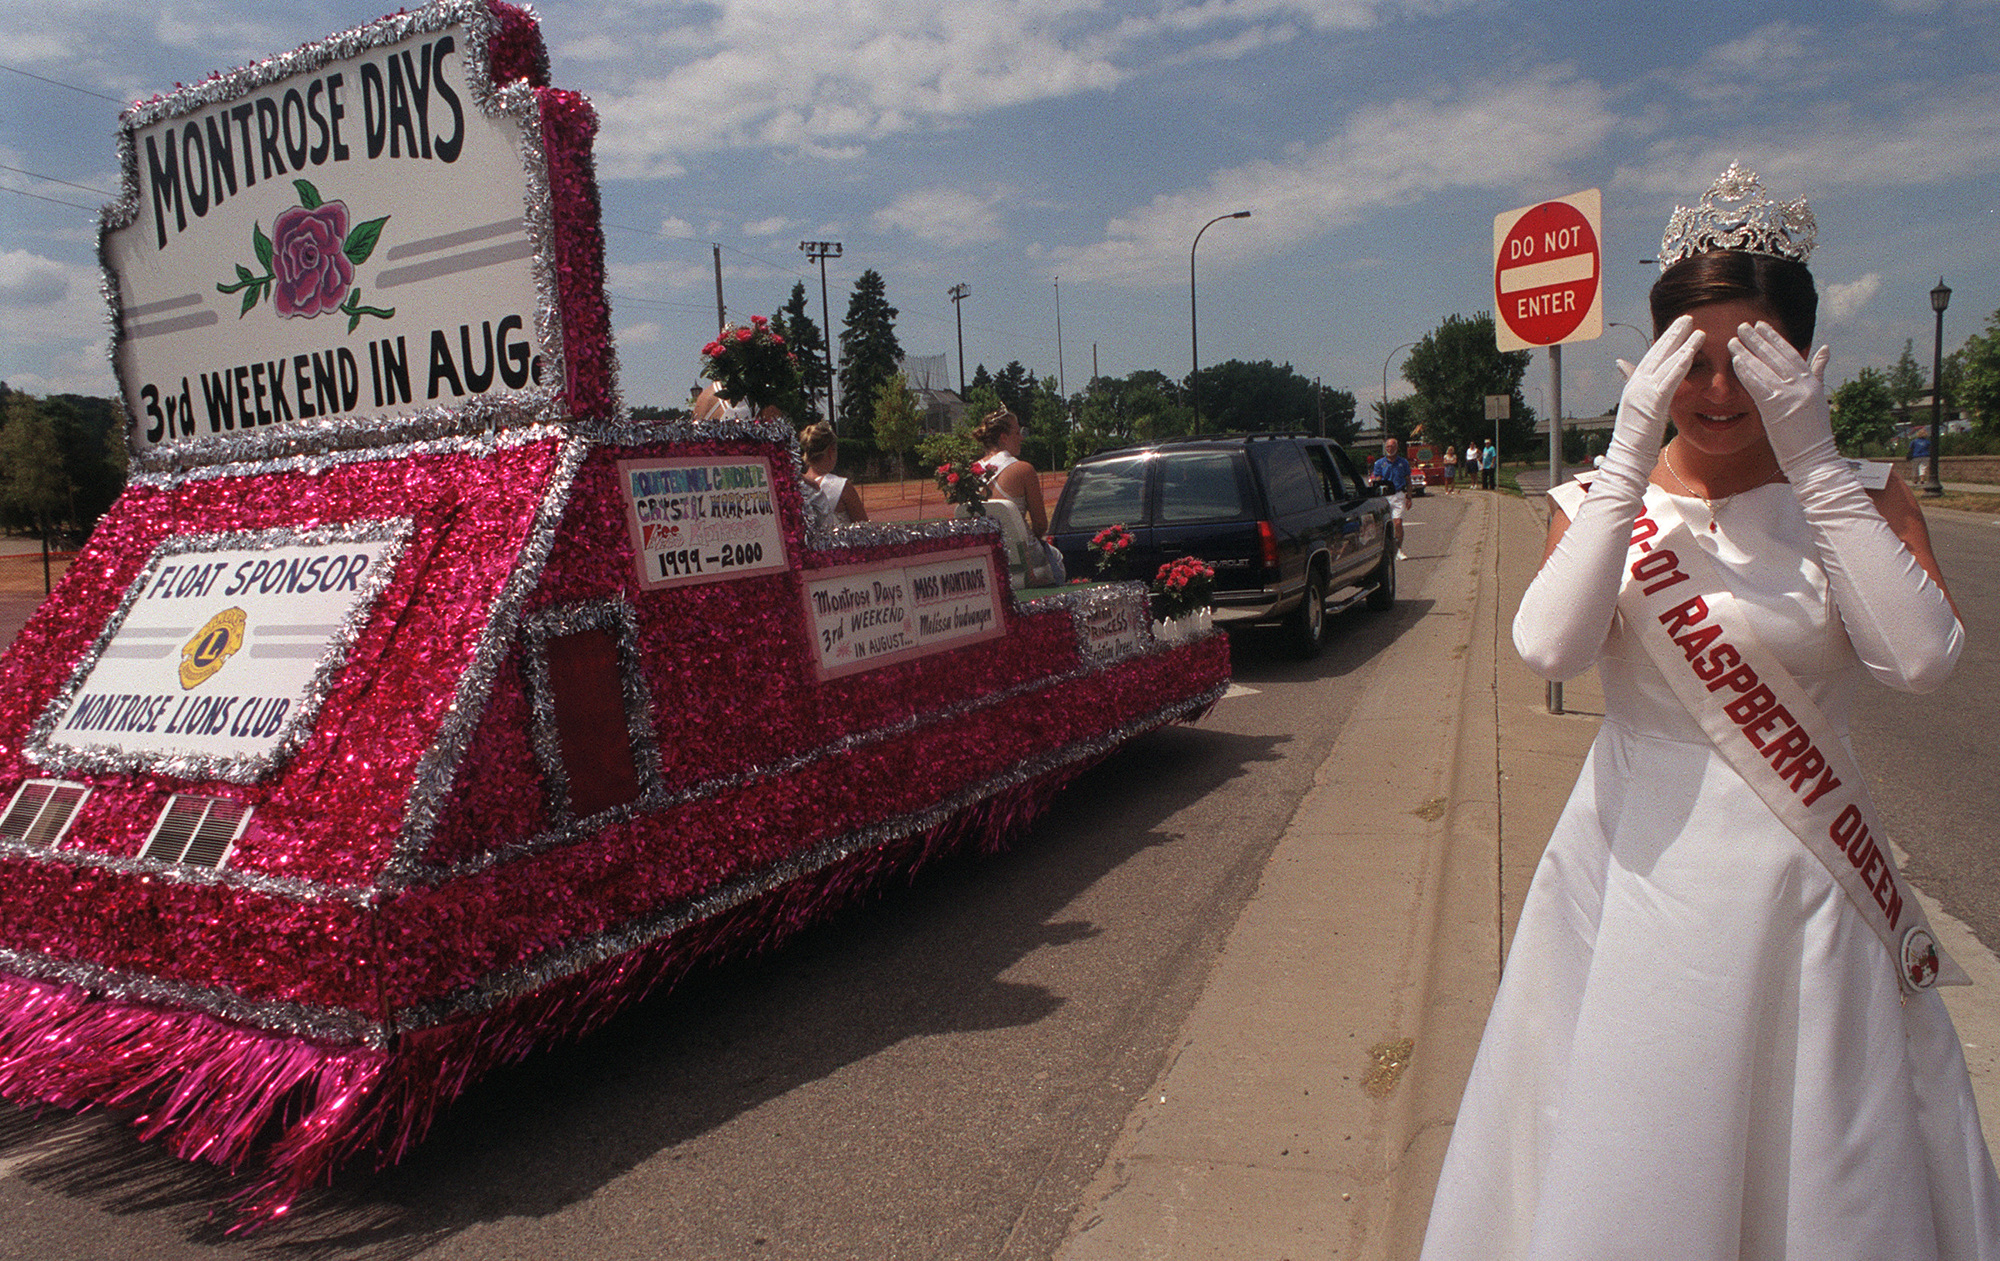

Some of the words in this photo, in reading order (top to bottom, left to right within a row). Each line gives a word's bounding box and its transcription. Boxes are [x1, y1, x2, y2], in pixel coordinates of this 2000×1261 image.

[145, 73, 350, 250] MONTROSE
[360, 36, 465, 163] DAYS
[1511, 236, 1534, 260] DO
[1545, 225, 1581, 253] NOT
[1517, 290, 1576, 319] ENTER
[140, 377, 196, 443] 3rd
[369, 336, 412, 406] IN
[637, 495, 706, 523] CRYSTAL
[146, 562, 228, 600] FLOAT
[224, 554, 370, 596] SPONSOR
[913, 575, 939, 599] MISS
[940, 569, 986, 595] MONTROSE
[813, 586, 871, 614] Montrose
[873, 581, 903, 605] Days
[822, 618, 844, 652] 3rd
[851, 607, 904, 632] WEEKEND
[919, 611, 951, 636] Melissa
[854, 642, 866, 658] IN
[65, 694, 174, 732] MONTROSE
[164, 696, 239, 736] LIONS
[230, 698, 291, 738] CLUB
[1658, 594, 1842, 808] RASPBERRY
[1829, 803, 1904, 932] QUEEN
